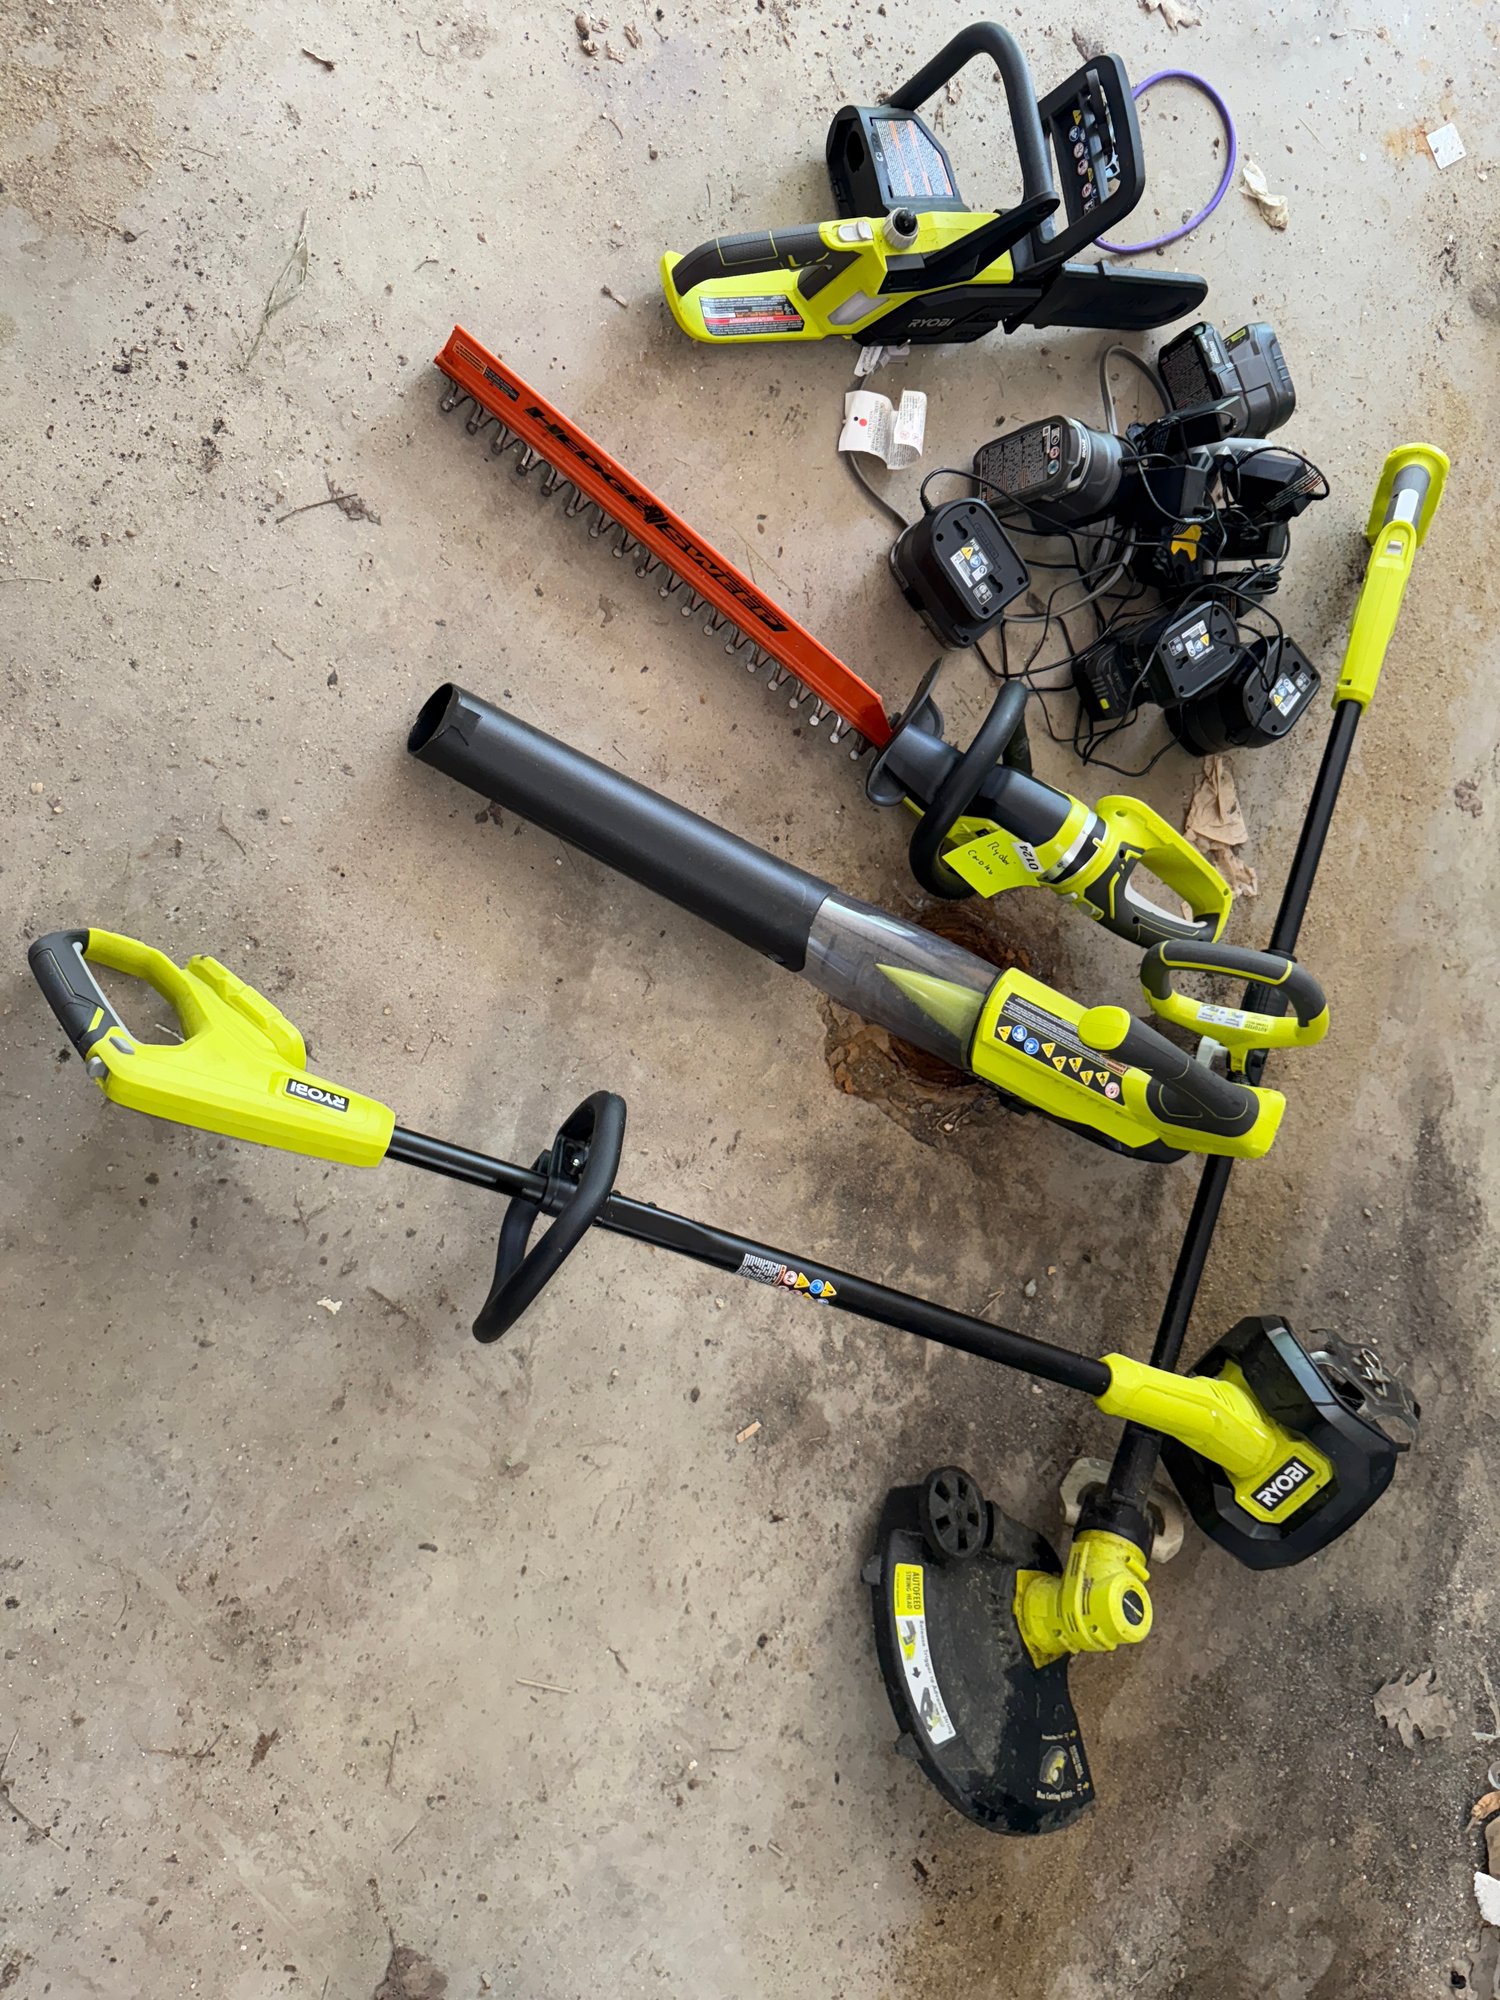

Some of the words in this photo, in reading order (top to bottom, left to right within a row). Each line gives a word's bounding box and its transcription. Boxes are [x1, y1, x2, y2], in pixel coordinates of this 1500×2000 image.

[908, 318, 955, 328] RYOBI
[524, 406, 649, 513] HEDGE
[655, 522, 789, 632] SWEEP
[1019, 845, 1039, 871] 0124
[290, 1081, 346, 1109] RYOBI
[1256, 1461, 1309, 1507] RYOBI
[912, 1571, 921, 1610] AUTOFEED
